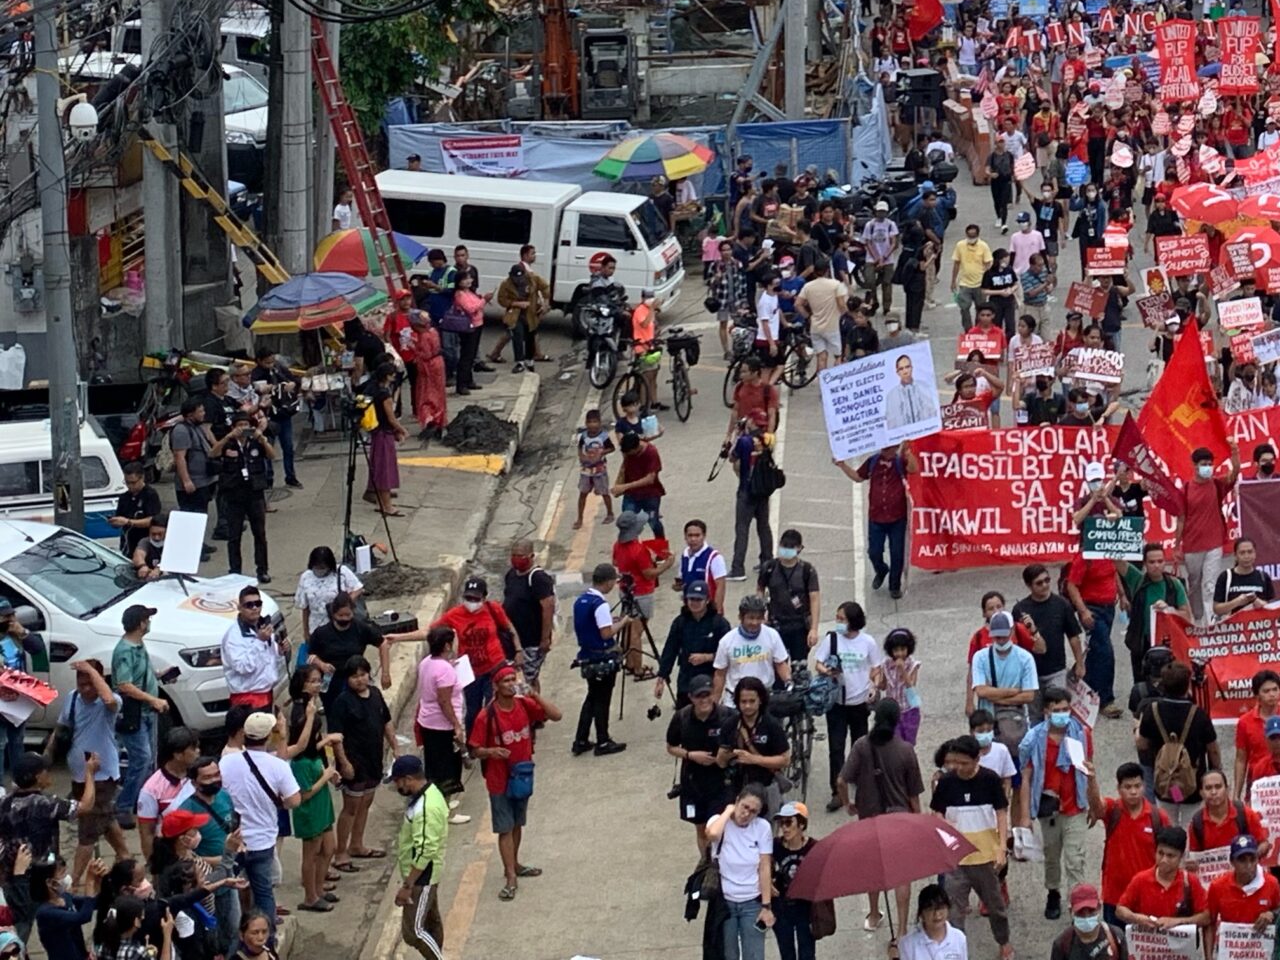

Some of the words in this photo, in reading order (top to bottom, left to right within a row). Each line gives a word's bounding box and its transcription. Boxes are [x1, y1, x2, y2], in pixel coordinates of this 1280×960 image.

[1078, 347, 1126, 369] MARCOS
[822, 359, 887, 384] Congratulations
[830, 381, 855, 395] NEWLY
[856, 372, 886, 387] ELECTED
[853, 386, 885, 401] DANIEL
[835, 395, 884, 415] RONQUILLO
[945, 416, 982, 430] SCAM!
[990, 426, 1110, 456] ISKOLAR
[919, 451, 1054, 480] IPAGSILBI
[1011, 480, 1048, 509] SA
[912, 507, 1011, 536] ITAKWIL
[1117, 518, 1134, 530] ALL
[1118, 530, 1144, 541] PRESS
[918, 543, 948, 557] ALAY
[1000, 541, 1065, 556] ANAKBAYAN
[1247, 619, 1273, 632] ANG
[1200, 632, 1247, 648] IBASURA
[1250, 629, 1275, 643] ANG
[733, 644, 762, 659] bike
[1188, 643, 1230, 659] DAGDAG
[1217, 853, 1228, 862] NG
[1130, 933, 1170, 946] TRABAHO,
[1224, 931, 1249, 939] SIGAW
[1250, 931, 1262, 939] NG
[1224, 940, 1264, 950] TRABAHO,
[1228, 950, 1269, 960] PAGKAIN,
